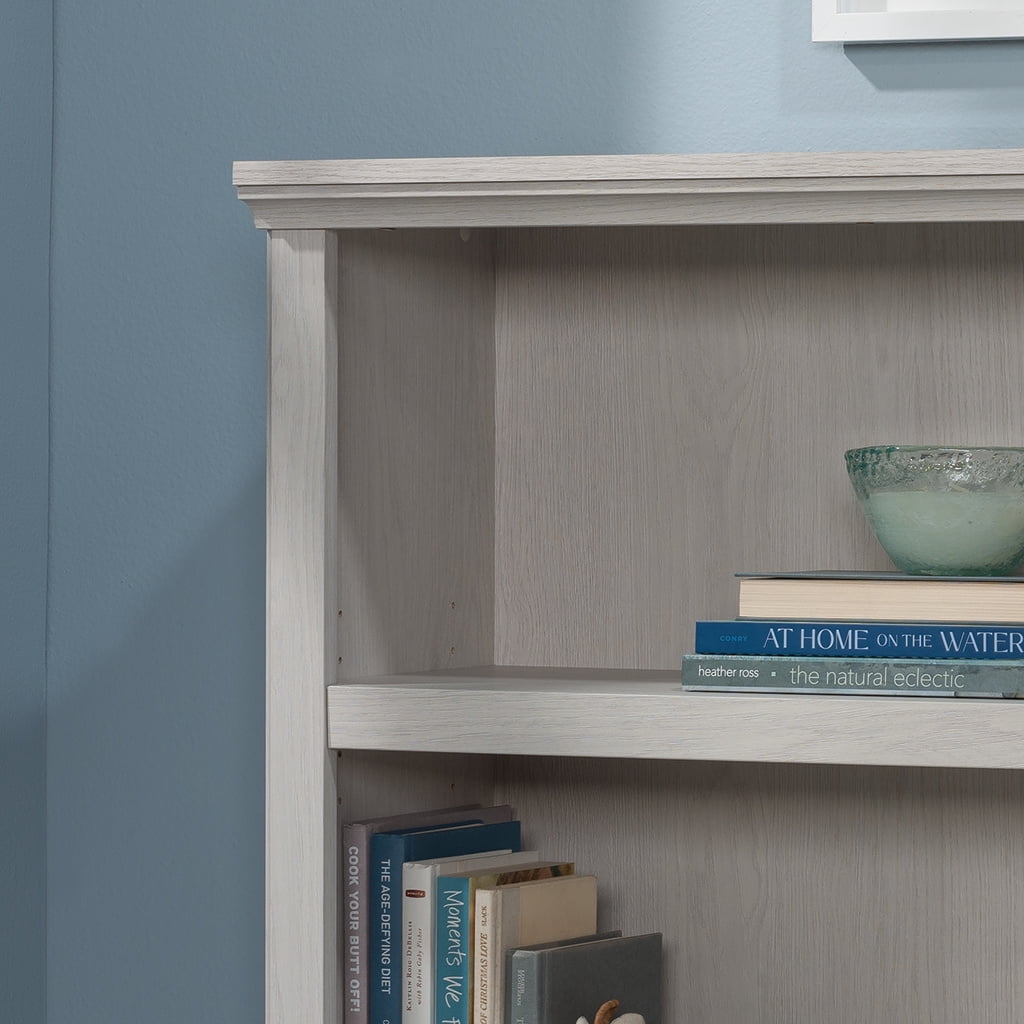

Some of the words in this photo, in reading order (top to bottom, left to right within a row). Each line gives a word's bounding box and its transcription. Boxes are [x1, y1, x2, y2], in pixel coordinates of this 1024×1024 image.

[719, 634, 749, 642] CONRY
[763, 628, 794, 648] AT
[800, 629, 869, 650] HOME
[877, 633, 899, 648] ON
[902, 634, 933, 648] THE
[940, 631, 1024, 653] WATER
[698, 664, 736, 678] heather
[739, 668, 760, 678] ross
[790, 665, 820, 685] the
[825, 667, 887, 686] natural
[893, 668, 965, 689] eclectic
[348, 846, 359, 885] COOK
[381, 859, 390, 882] THE
[349, 891, 359, 932] YOUR
[381, 884, 391, 965] AGE-DEFYING
[444, 890, 465, 967] Moments
[349, 936, 360, 975] BUTT
[350, 980, 361, 1013] OFF!
[382, 967, 391, 995] DIET
[443, 976, 463, 1008] We
[480, 957, 488, 1011] CHRISTMAS
[480, 1012, 488, 1024] OF
